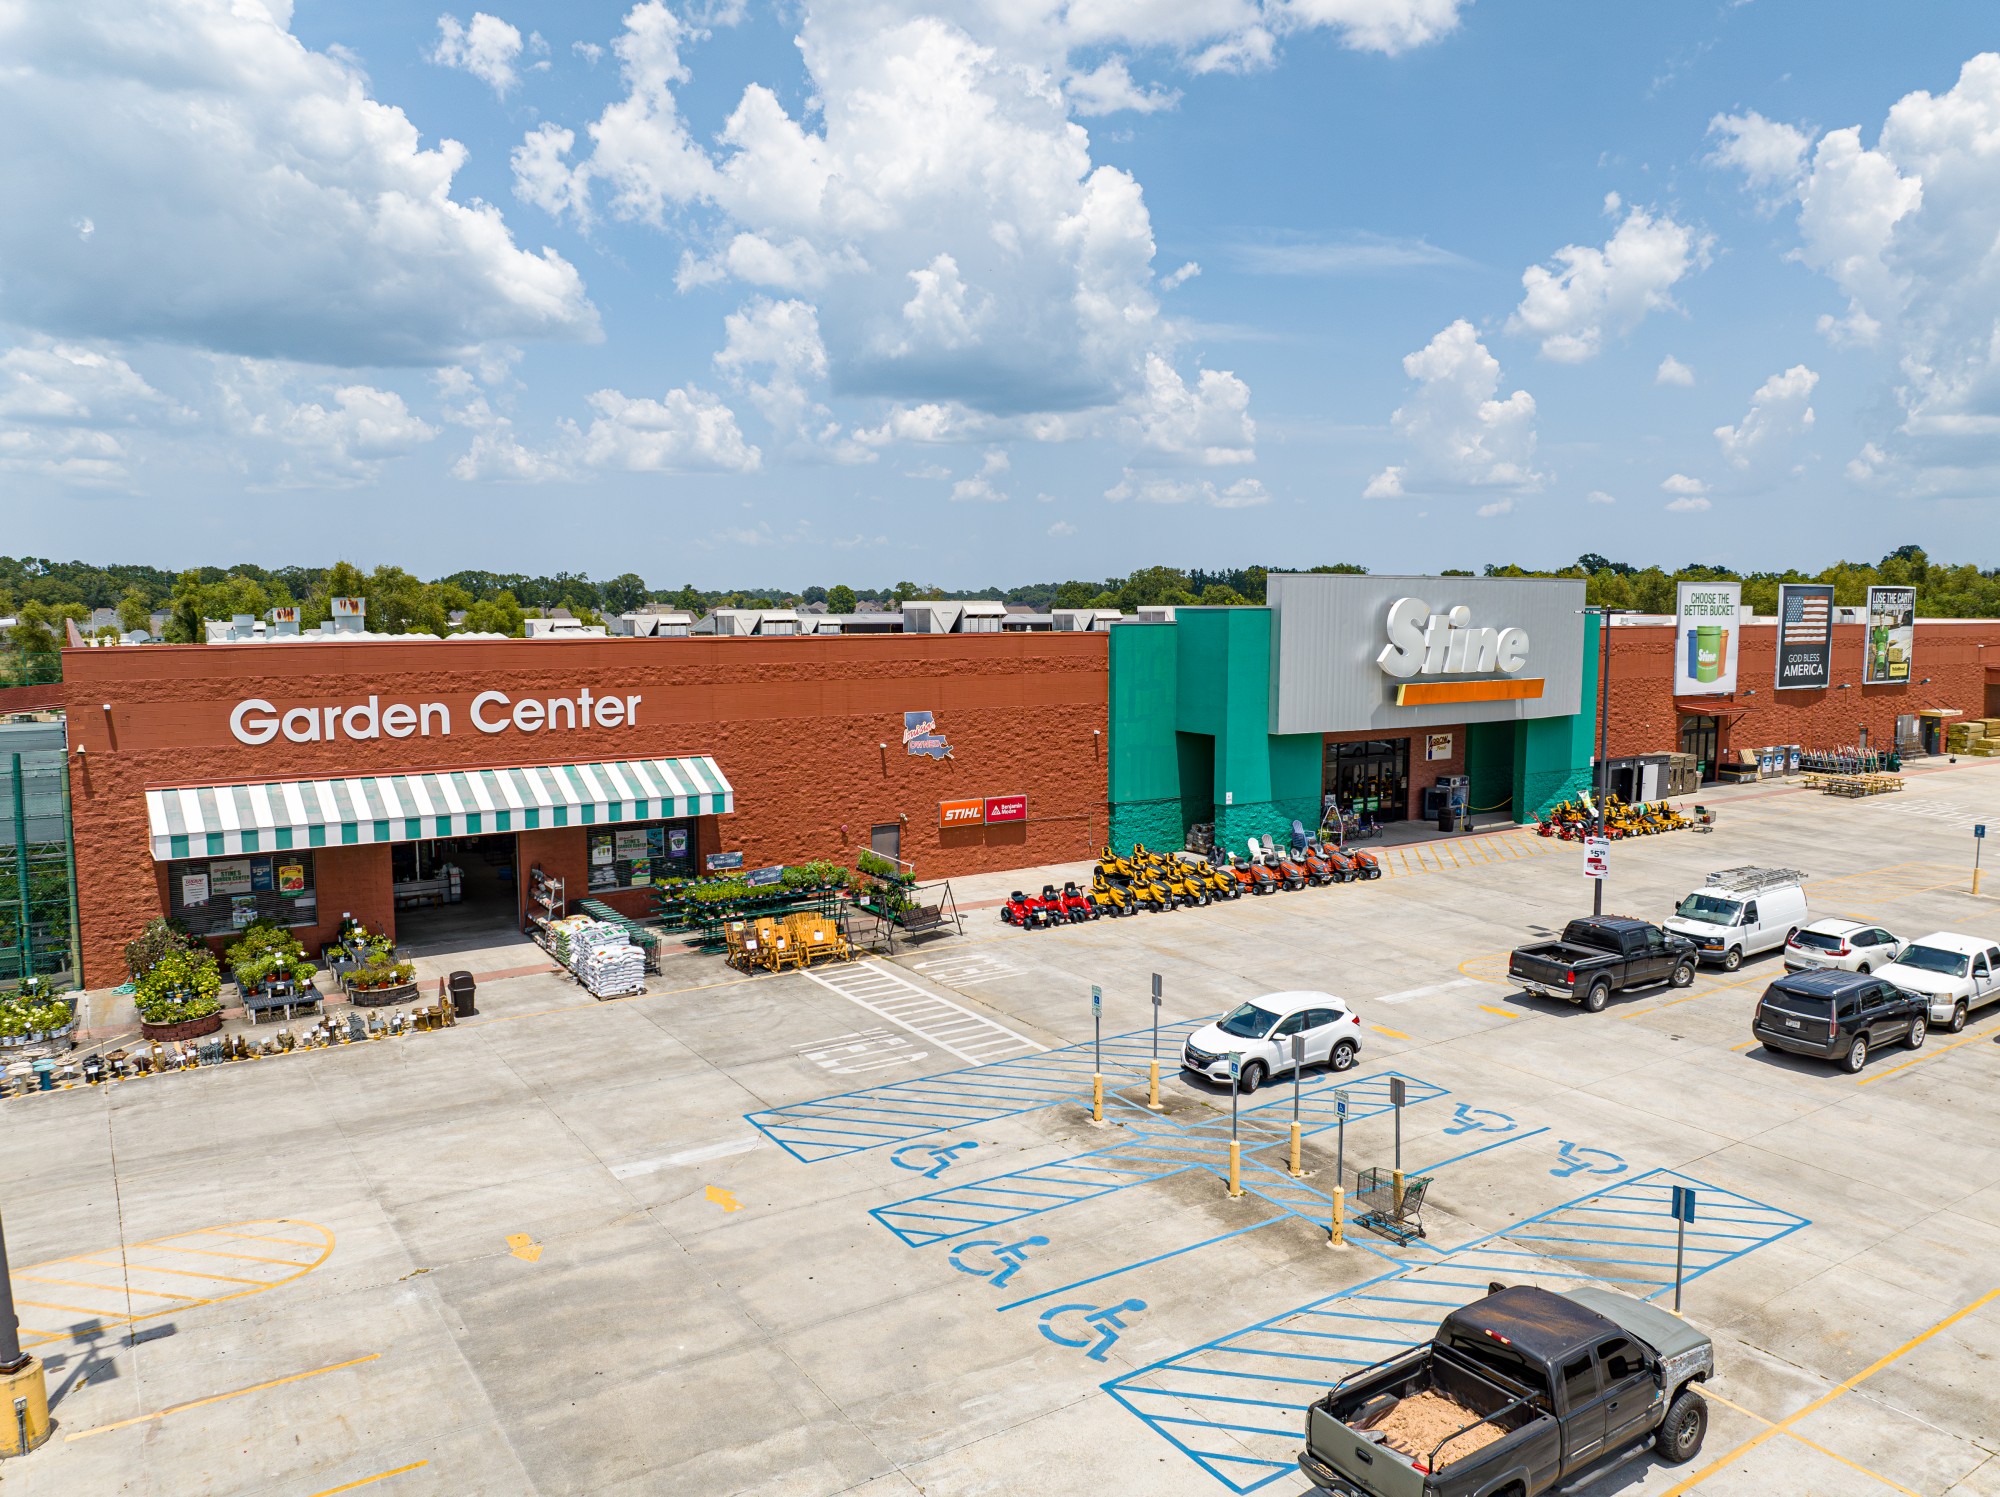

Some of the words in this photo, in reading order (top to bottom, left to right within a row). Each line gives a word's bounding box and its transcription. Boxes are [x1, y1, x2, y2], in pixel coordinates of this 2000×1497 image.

[1690, 592, 1717, 604] CHOOSE
[1718, 593, 1730, 604] THE
[1872, 592, 1886, 604] LOSE
[1887, 592, 1897, 604] THE
[1897, 592, 1913, 604] CART!
[1684, 604, 1708, 616] BETTER
[1376, 597, 1530, 678] Stine
[1698, 648, 1717, 662] Stine
[1788, 654, 1802, 663] GOD
[1803, 653, 1820, 662] BLESS
[1783, 663, 1824, 677] AMERICA
[229, 694, 450, 745] Garden
[469, 687, 642, 734] Center
[1001, 802, 1023, 811] Benjamin
[944, 807, 981, 821] STIHL
